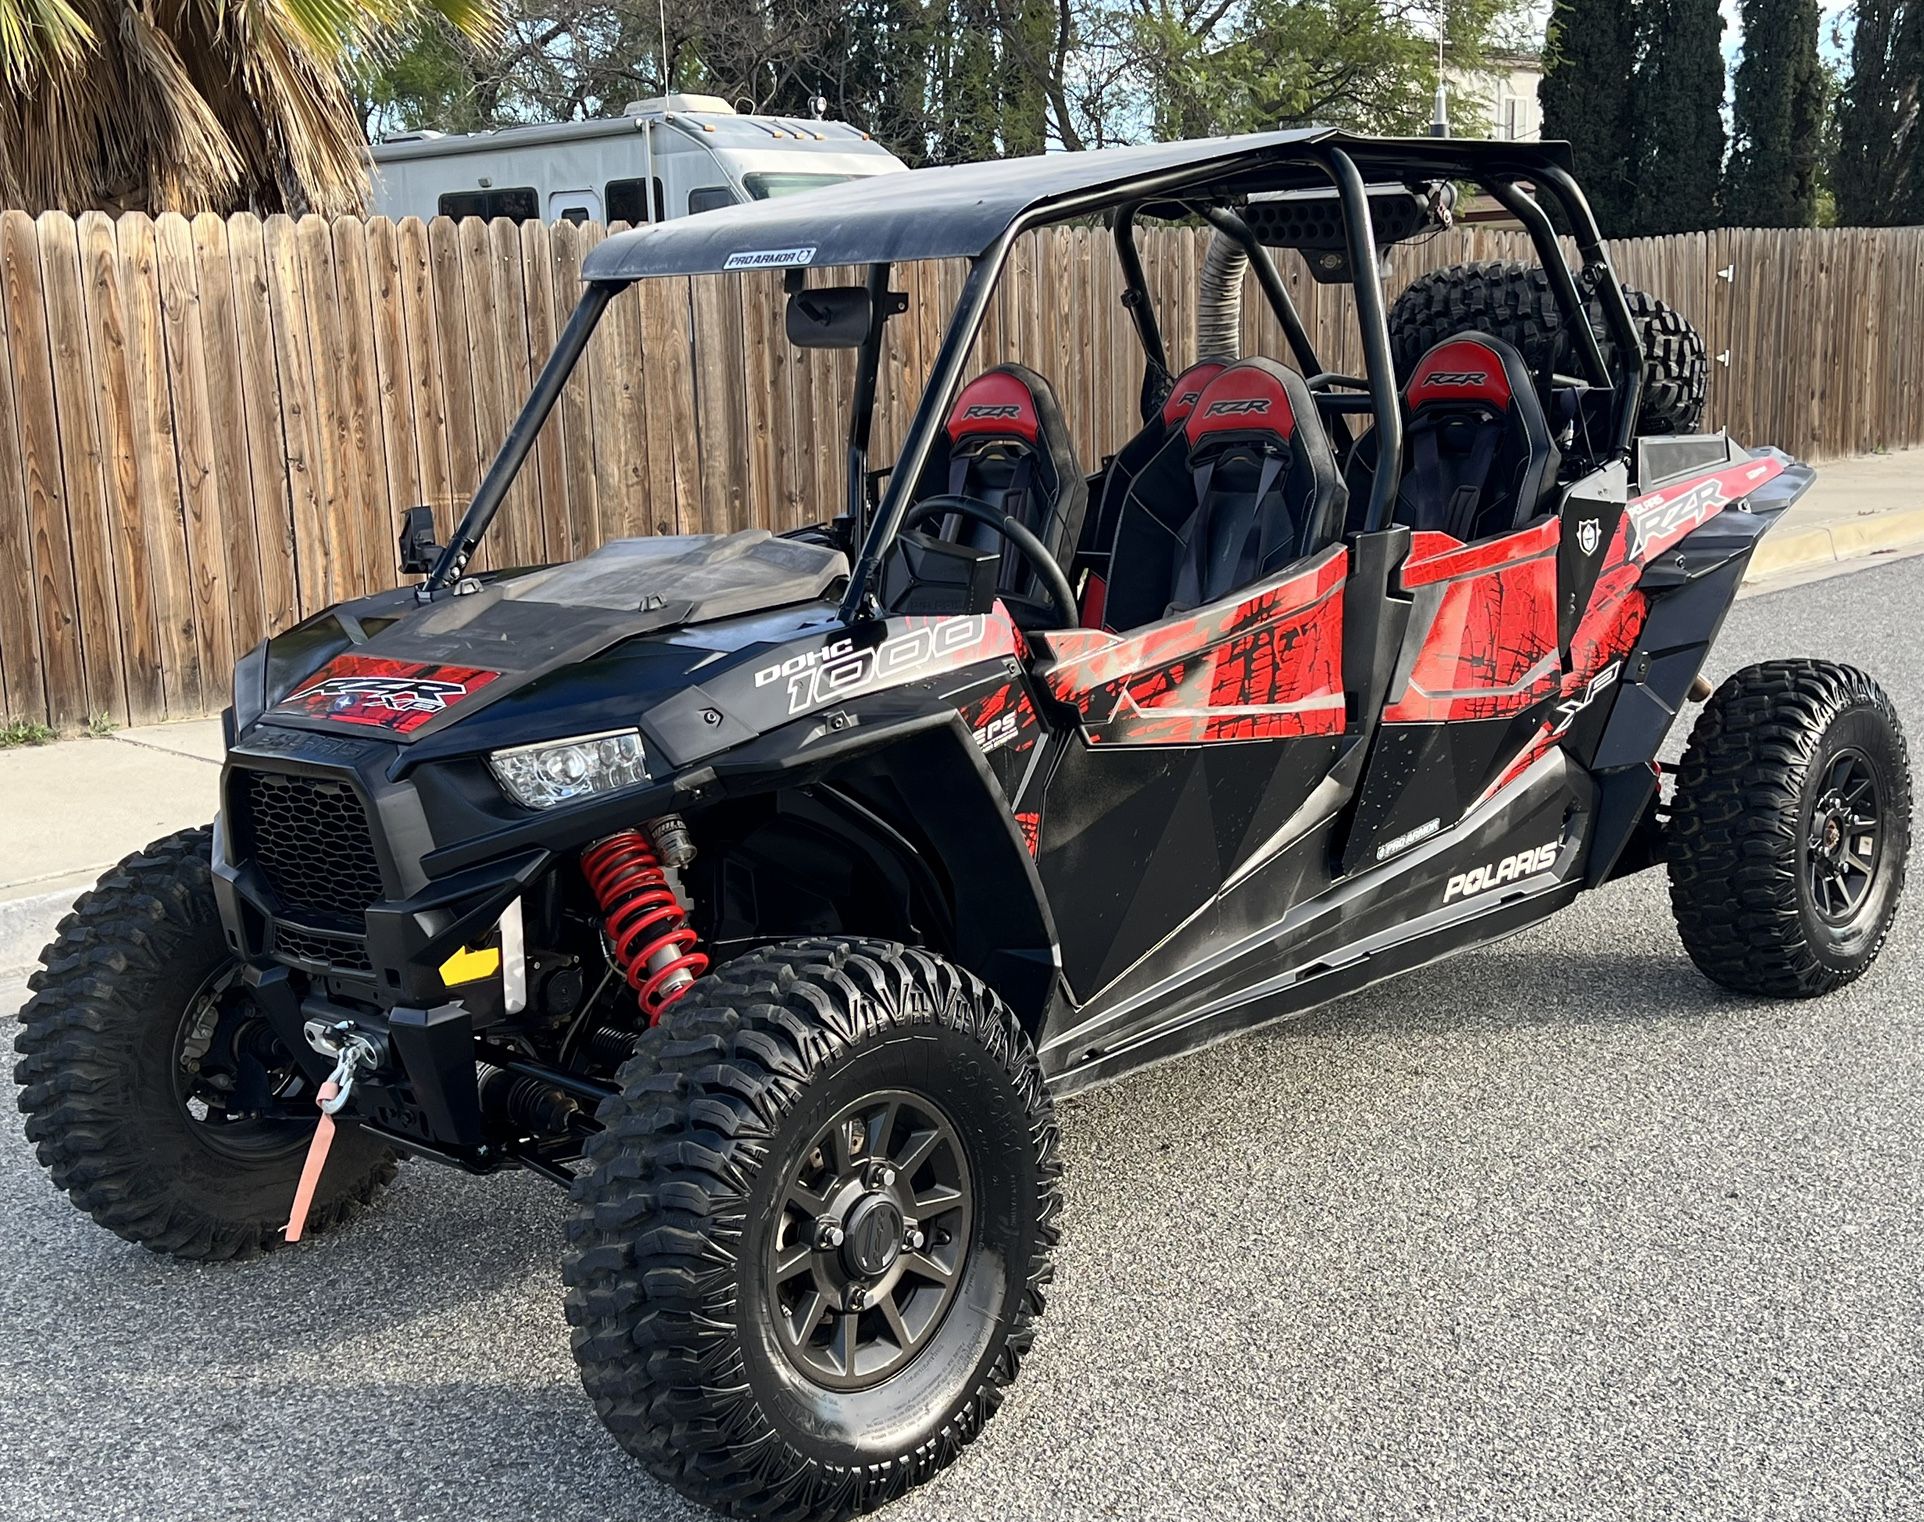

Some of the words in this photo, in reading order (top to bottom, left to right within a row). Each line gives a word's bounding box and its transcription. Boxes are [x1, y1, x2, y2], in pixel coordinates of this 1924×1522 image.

[752, 252, 797, 265] ARMOR
[1421, 371, 1488, 388] RZR
[961, 404, 1022, 421] RZR
[1202, 398, 1271, 419] RZR
[1629, 478, 1730, 561] RZR
[754, 638, 854, 687] DOHC
[786, 613, 986, 706] 1000
[281, 676, 466, 705] RZR
[361, 690, 448, 714] XP
[1552, 660, 1621, 736] XP
[972, 709, 1018, 746] EPS
[1443, 840, 1559, 904] POLARIS
